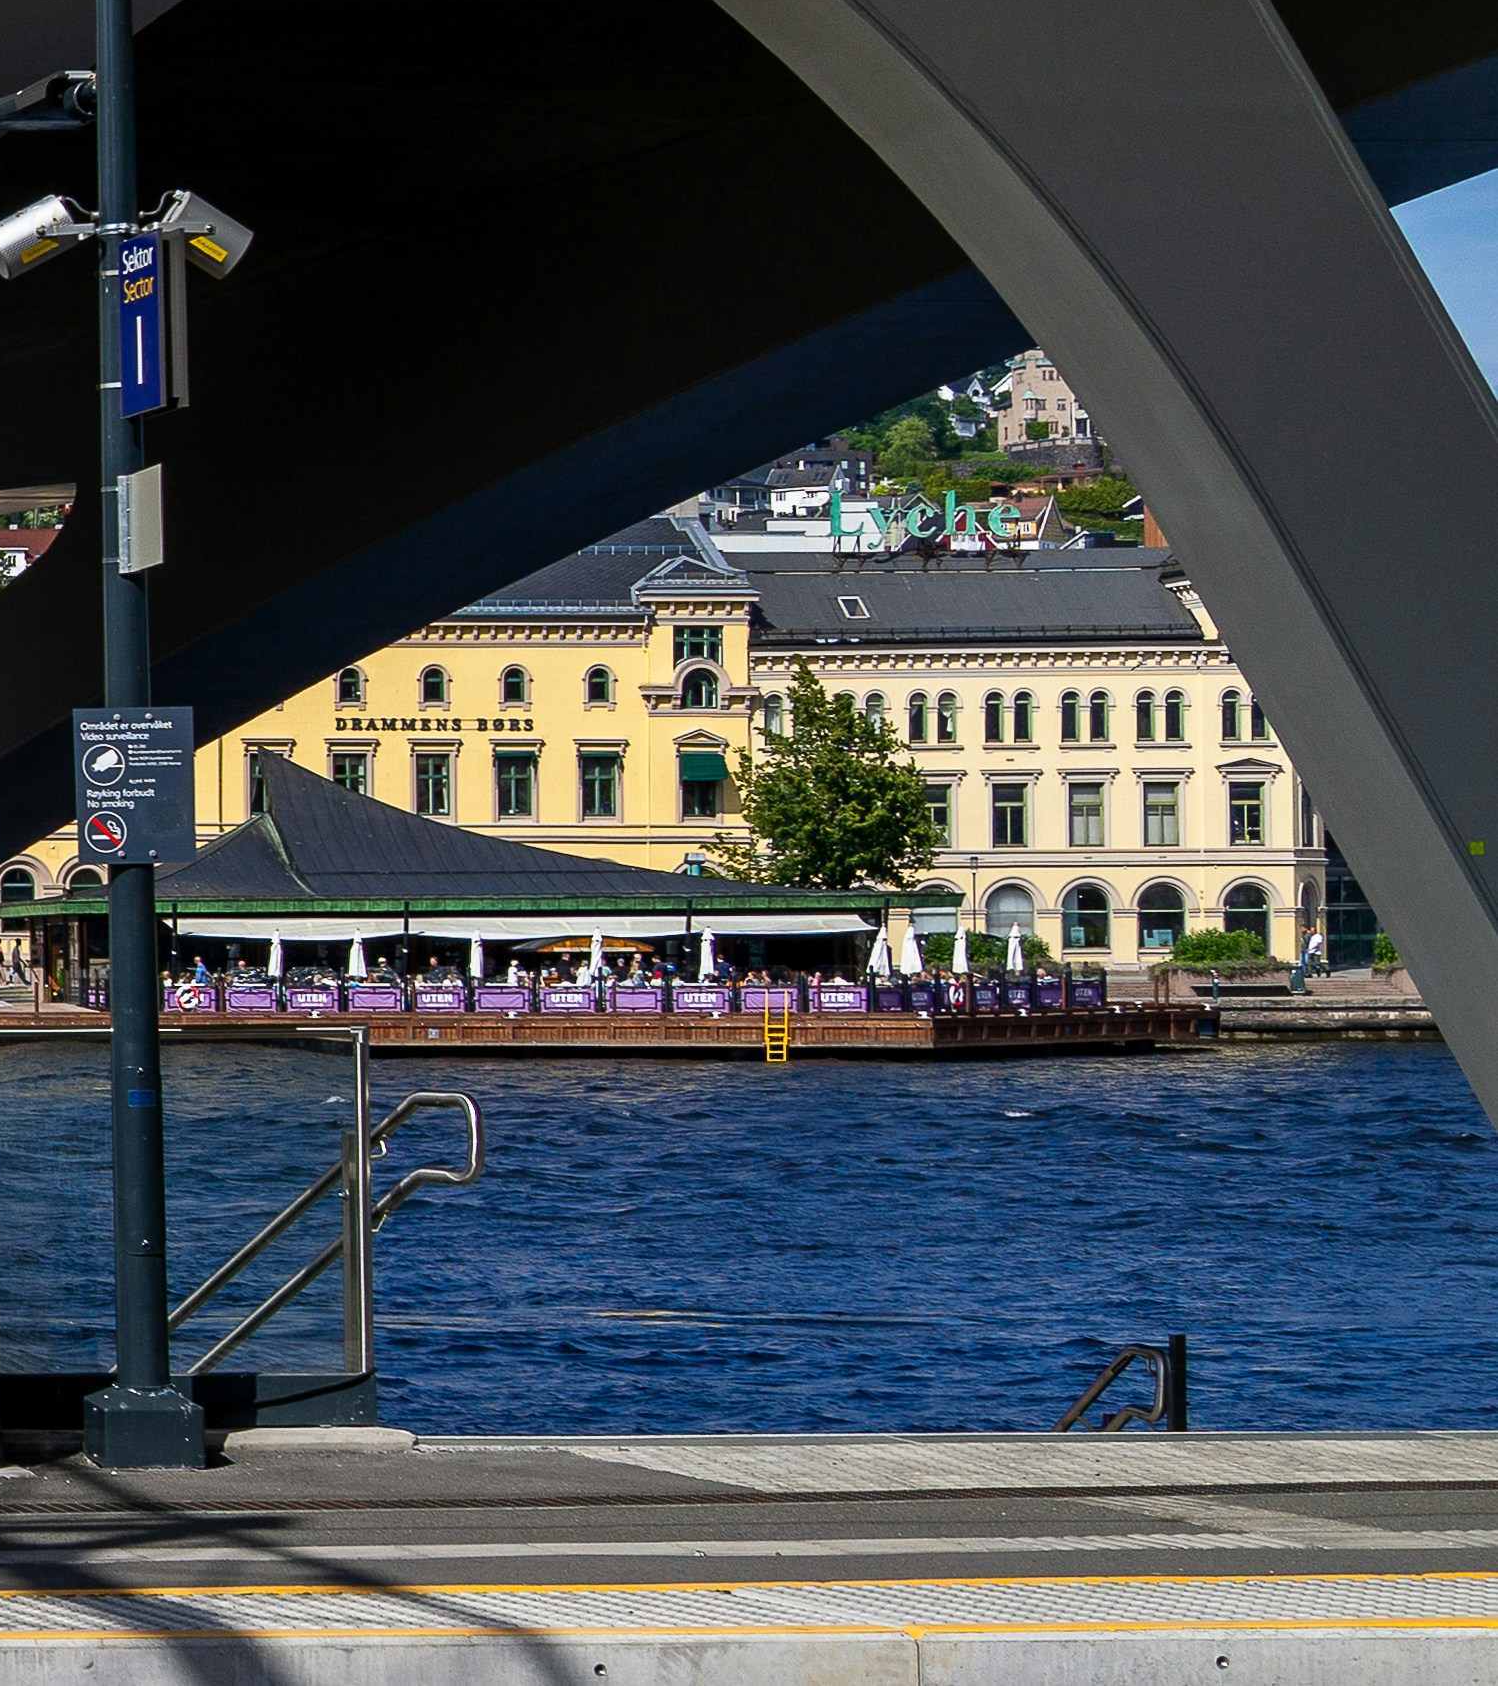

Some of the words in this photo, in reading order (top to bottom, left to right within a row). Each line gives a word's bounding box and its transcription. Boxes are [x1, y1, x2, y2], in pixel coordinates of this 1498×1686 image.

[122, 246, 154, 275] Sektor
[123, 275, 155, 305] Sector
[827, 489, 1022, 551] Lyche
[80, 721, 119, 731] Området
[130, 720, 173, 730] overvåket
[335, 718, 462, 732] DRAMMENS
[476, 718, 534, 732] BØRS
[80, 732, 104, 741] Video
[105, 731, 150, 741] surveillance
[86, 789, 121, 799] Røyking
[122, 789, 156, 798] forbudt
[87, 801, 100, 809] No
[101, 800, 135, 810] smoking
[297, 993, 327, 1003] UTEN
[421, 993, 453, 1003] UTEN
[550, 993, 584, 1003] UTEN
[683, 993, 717, 1003] UTEN
[820, 992, 855, 1003] UTEN
